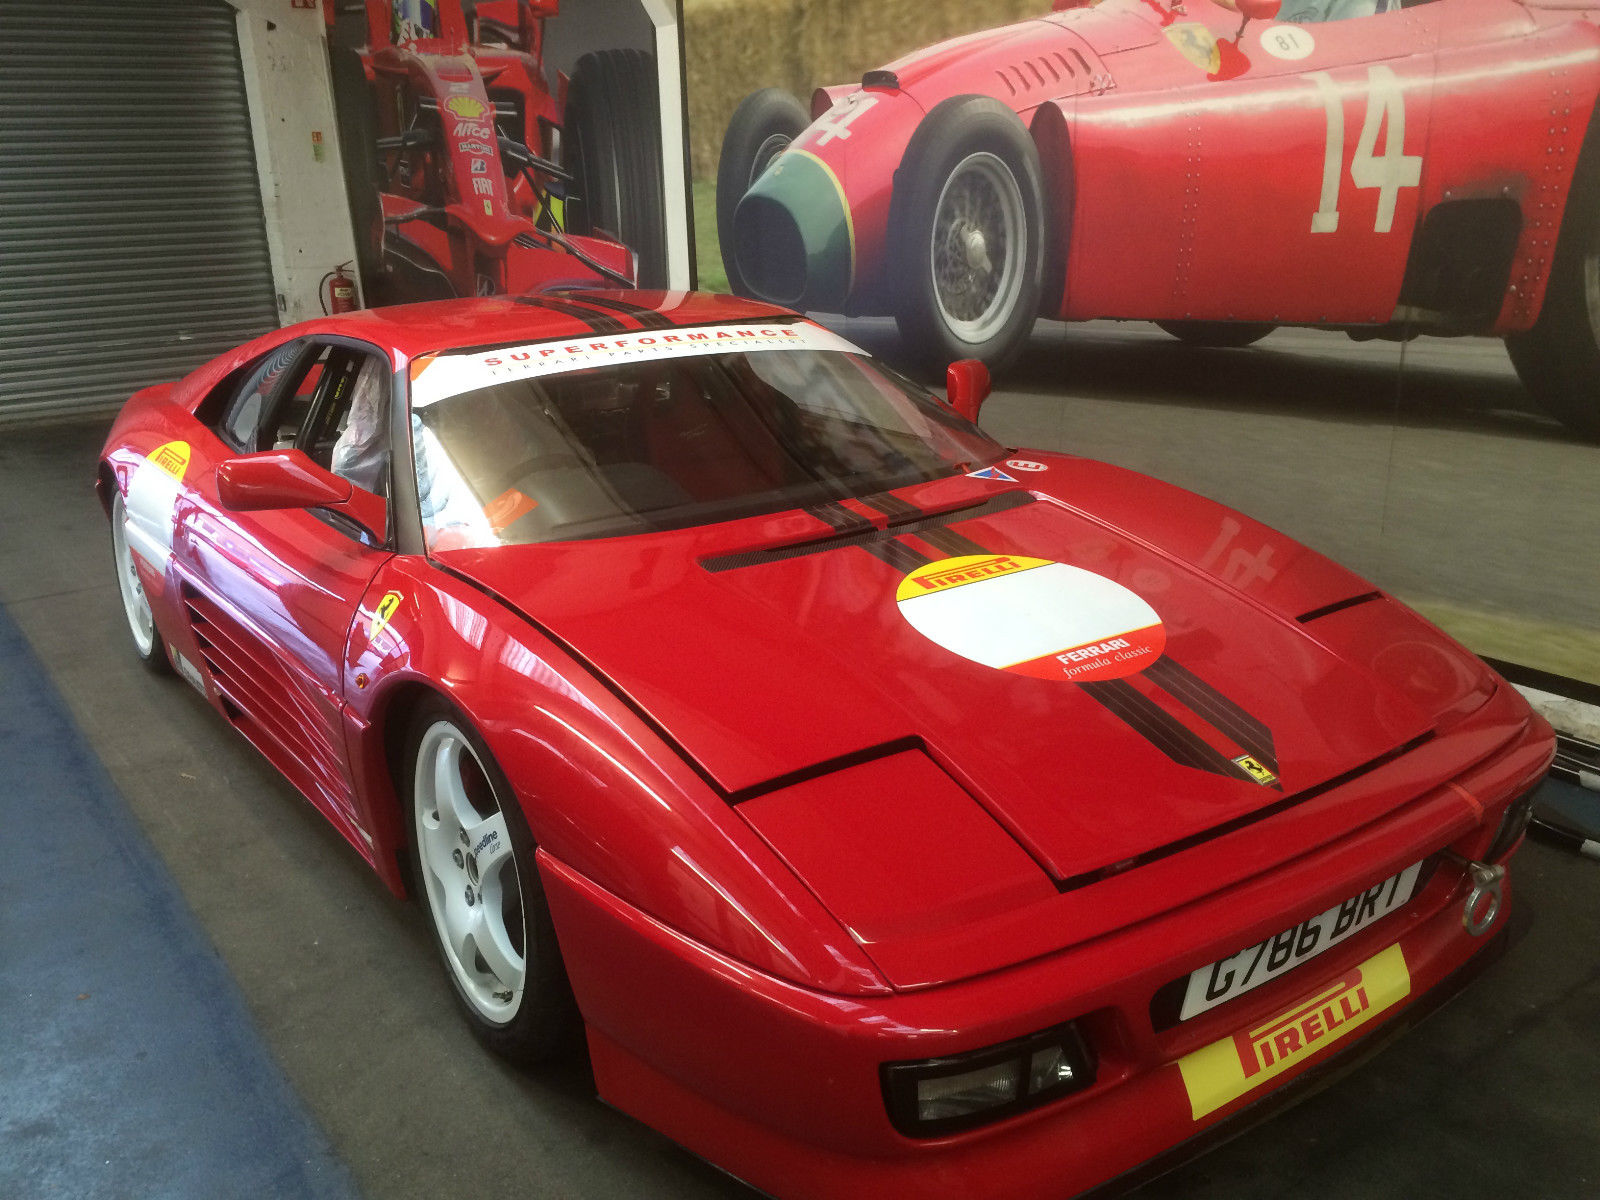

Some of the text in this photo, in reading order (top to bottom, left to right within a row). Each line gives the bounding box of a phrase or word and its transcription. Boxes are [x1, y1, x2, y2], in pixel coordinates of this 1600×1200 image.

[1274, 32, 1300, 51] 81
[1303, 65, 1423, 233] 14
[472, 177, 494, 196] FIAT
[484, 329, 799, 366] SUPERFORMANCE
[155, 447, 187, 475] PIRELLI
[911, 557, 1022, 590] PIRELLI
[1056, 638, 1131, 665] FERRARI
[1063, 645, 1153, 679] formula classic
[1206, 918, 1322, 1001] G786
[1233, 967, 1370, 1079] PIRELLI
